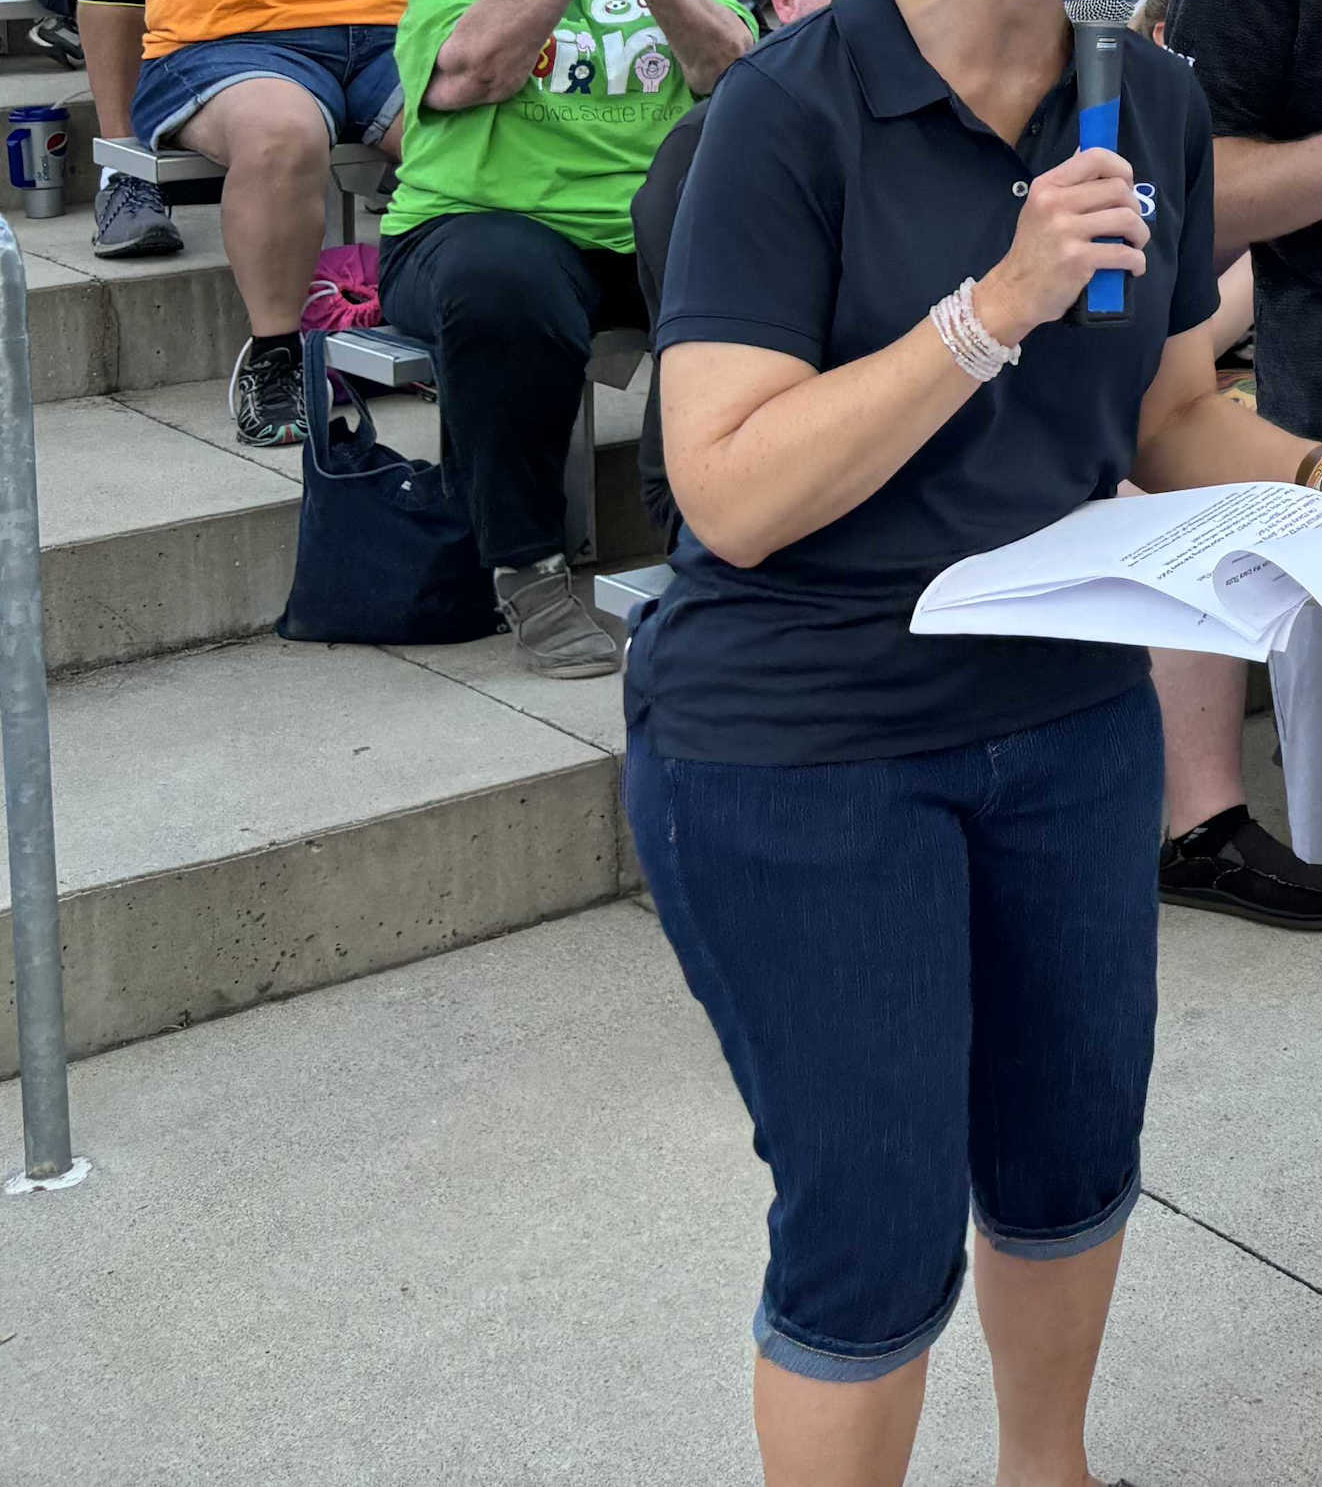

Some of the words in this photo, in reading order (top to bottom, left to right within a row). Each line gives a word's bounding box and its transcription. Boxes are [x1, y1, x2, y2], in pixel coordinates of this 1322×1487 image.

[520, 101, 576, 122] Iowa
[578, 102, 636, 123] State
[640, 101, 683, 122] Fair
